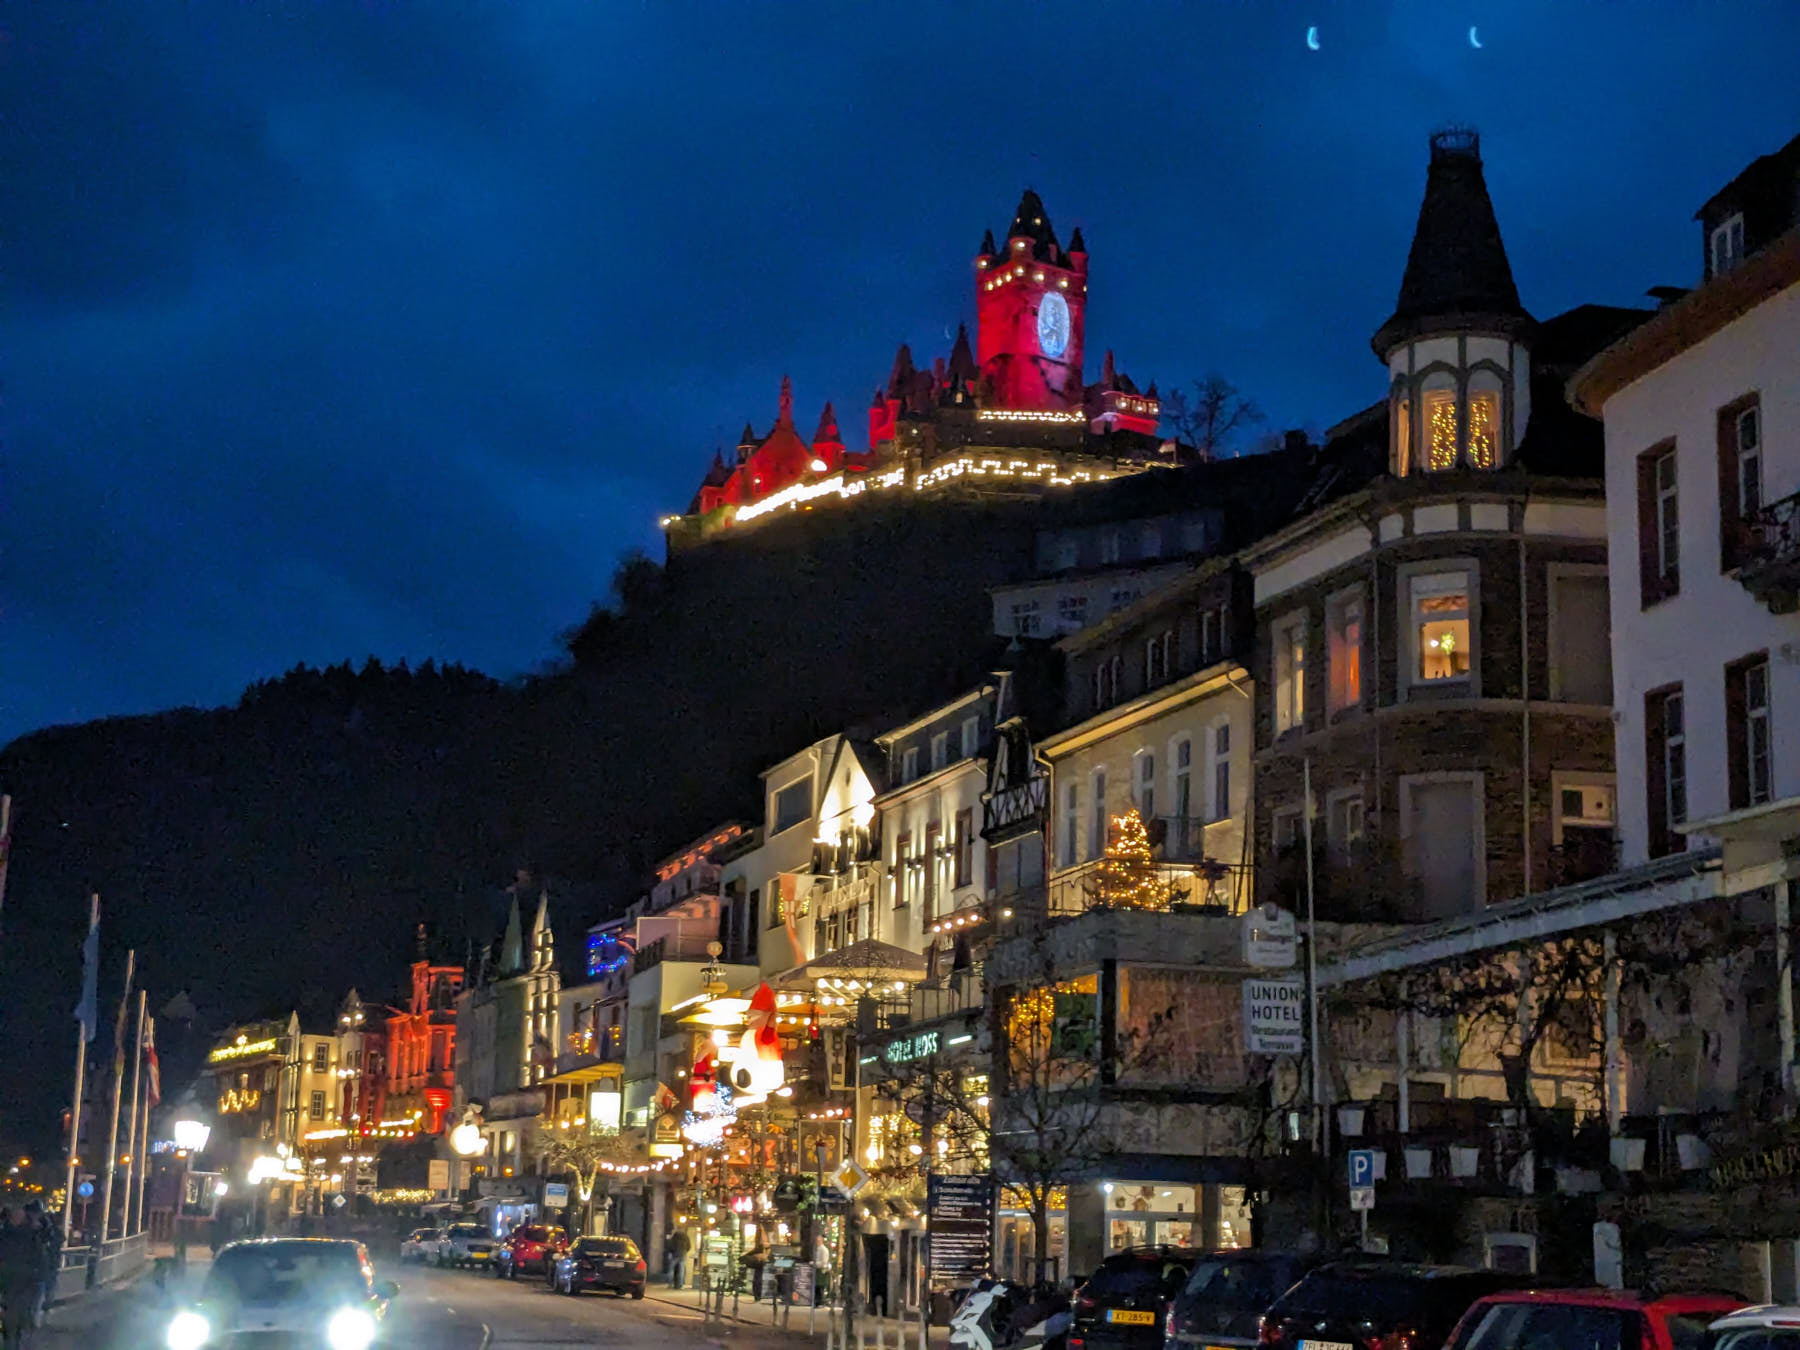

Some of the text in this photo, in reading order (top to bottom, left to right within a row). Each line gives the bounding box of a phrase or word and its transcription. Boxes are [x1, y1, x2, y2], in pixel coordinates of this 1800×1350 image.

[1251, 986, 1299, 1002] UNION
[1252, 1005, 1300, 1021] HOTEL
[1354, 1156, 1368, 1183] P
